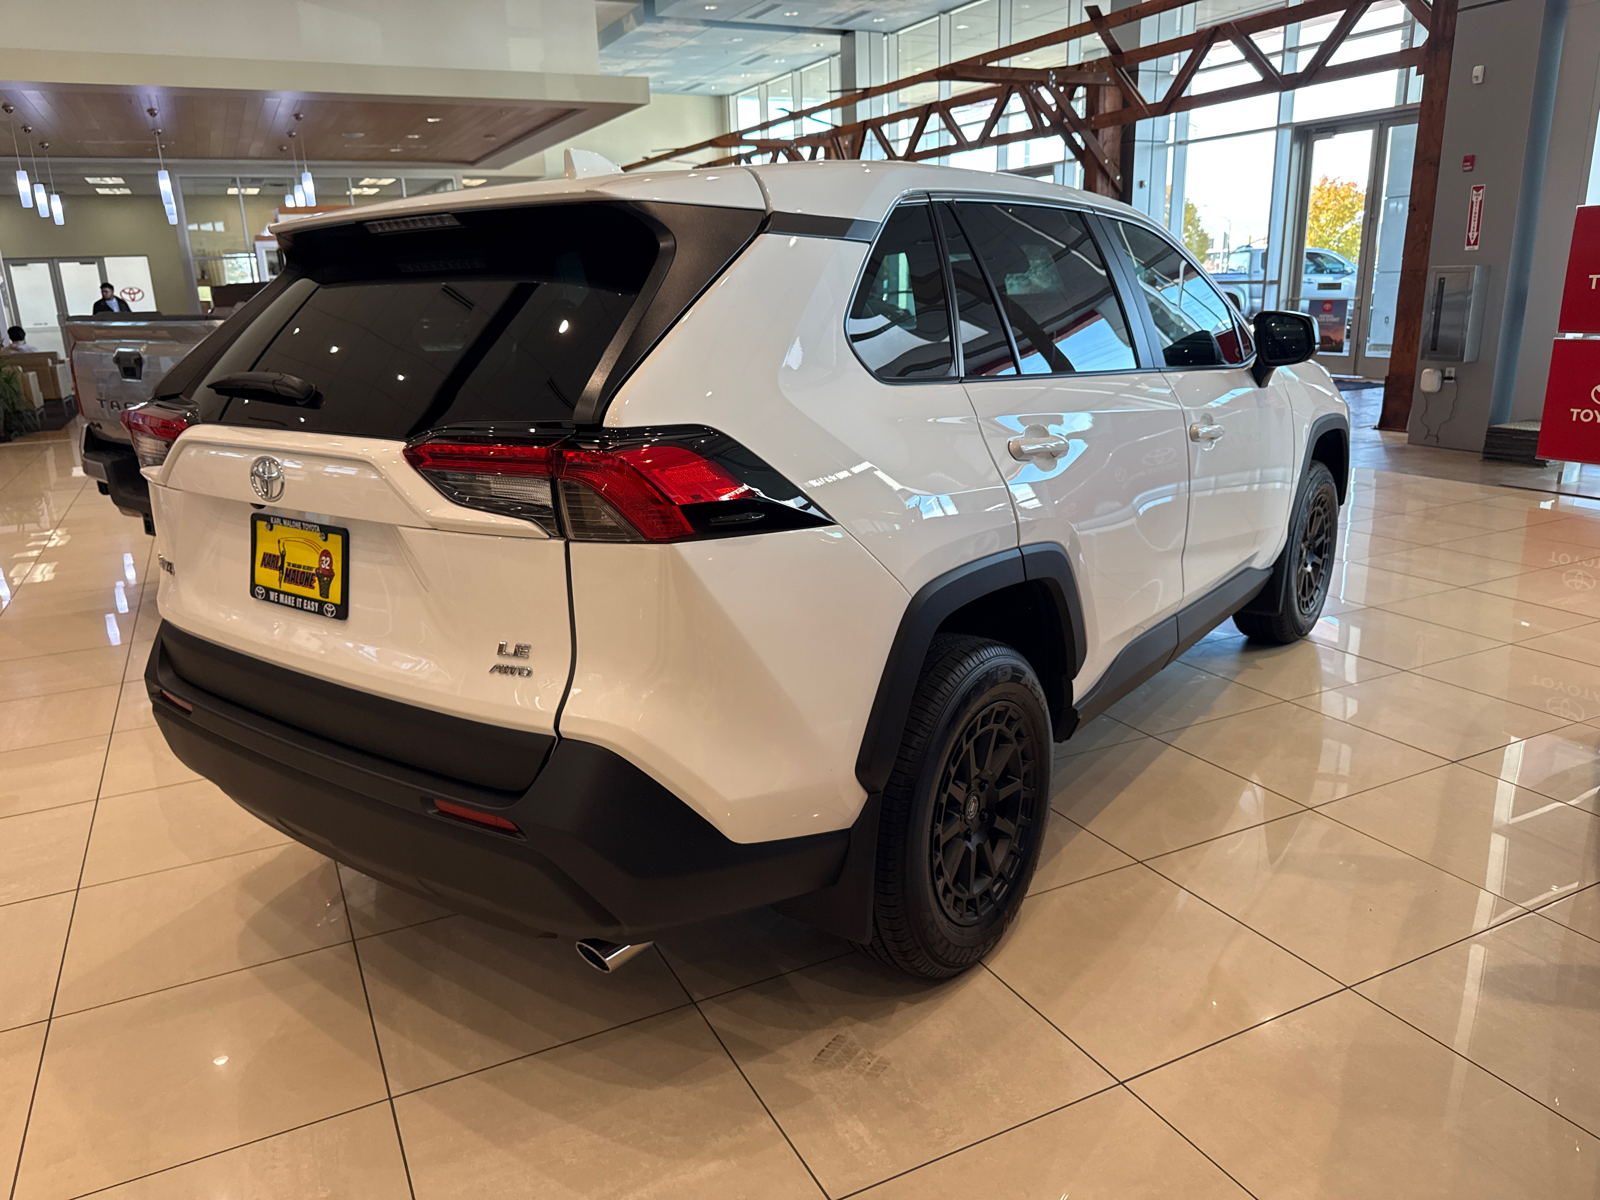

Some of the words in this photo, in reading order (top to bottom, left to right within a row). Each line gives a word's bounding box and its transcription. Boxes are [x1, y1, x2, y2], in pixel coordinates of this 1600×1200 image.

[270, 516, 282, 526] KARL
[283, 519, 302, 530] MALONE
[302, 522, 320, 533] TOYOTA
[260, 552, 281, 571] KARL
[321, 556, 331, 570] 32
[284, 567, 316, 590] MALONE
[269, 591, 278, 602] WE
[279, 593, 295, 607] MAKE
[296, 597, 303, 608] IT
[303, 599, 319, 612] EASY
[496, 641, 532, 660] LE
[488, 664, 533, 677] AWD
